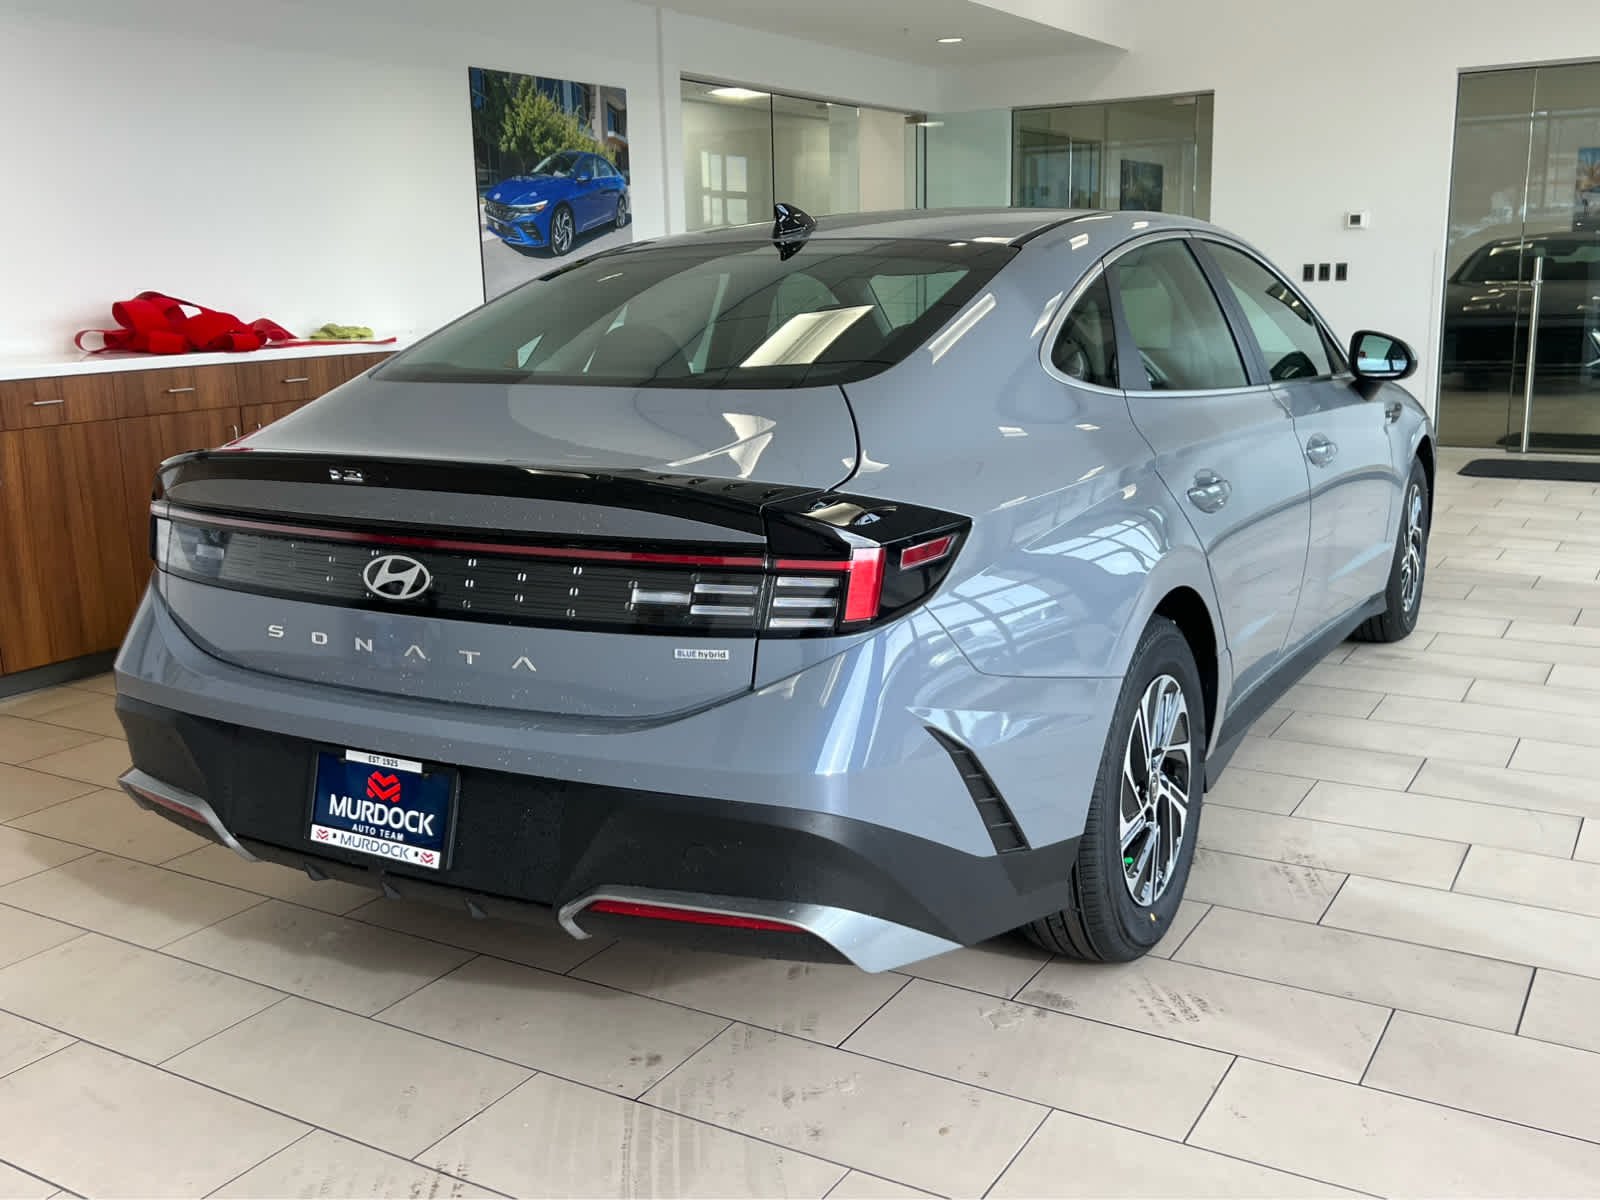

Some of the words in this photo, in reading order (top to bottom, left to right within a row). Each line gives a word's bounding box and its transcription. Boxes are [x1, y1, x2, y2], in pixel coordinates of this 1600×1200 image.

[268, 624, 536, 672] SONATA
[677, 650, 697, 658] BLUE
[698, 651, 727, 659] hybrid
[382, 757, 399, 767] 1925
[329, 794, 435, 836] MURDOCK
[352, 824, 377, 835] AUTO
[380, 829, 404, 841] TEAM
[339, 833, 410, 860] MURDOCK
